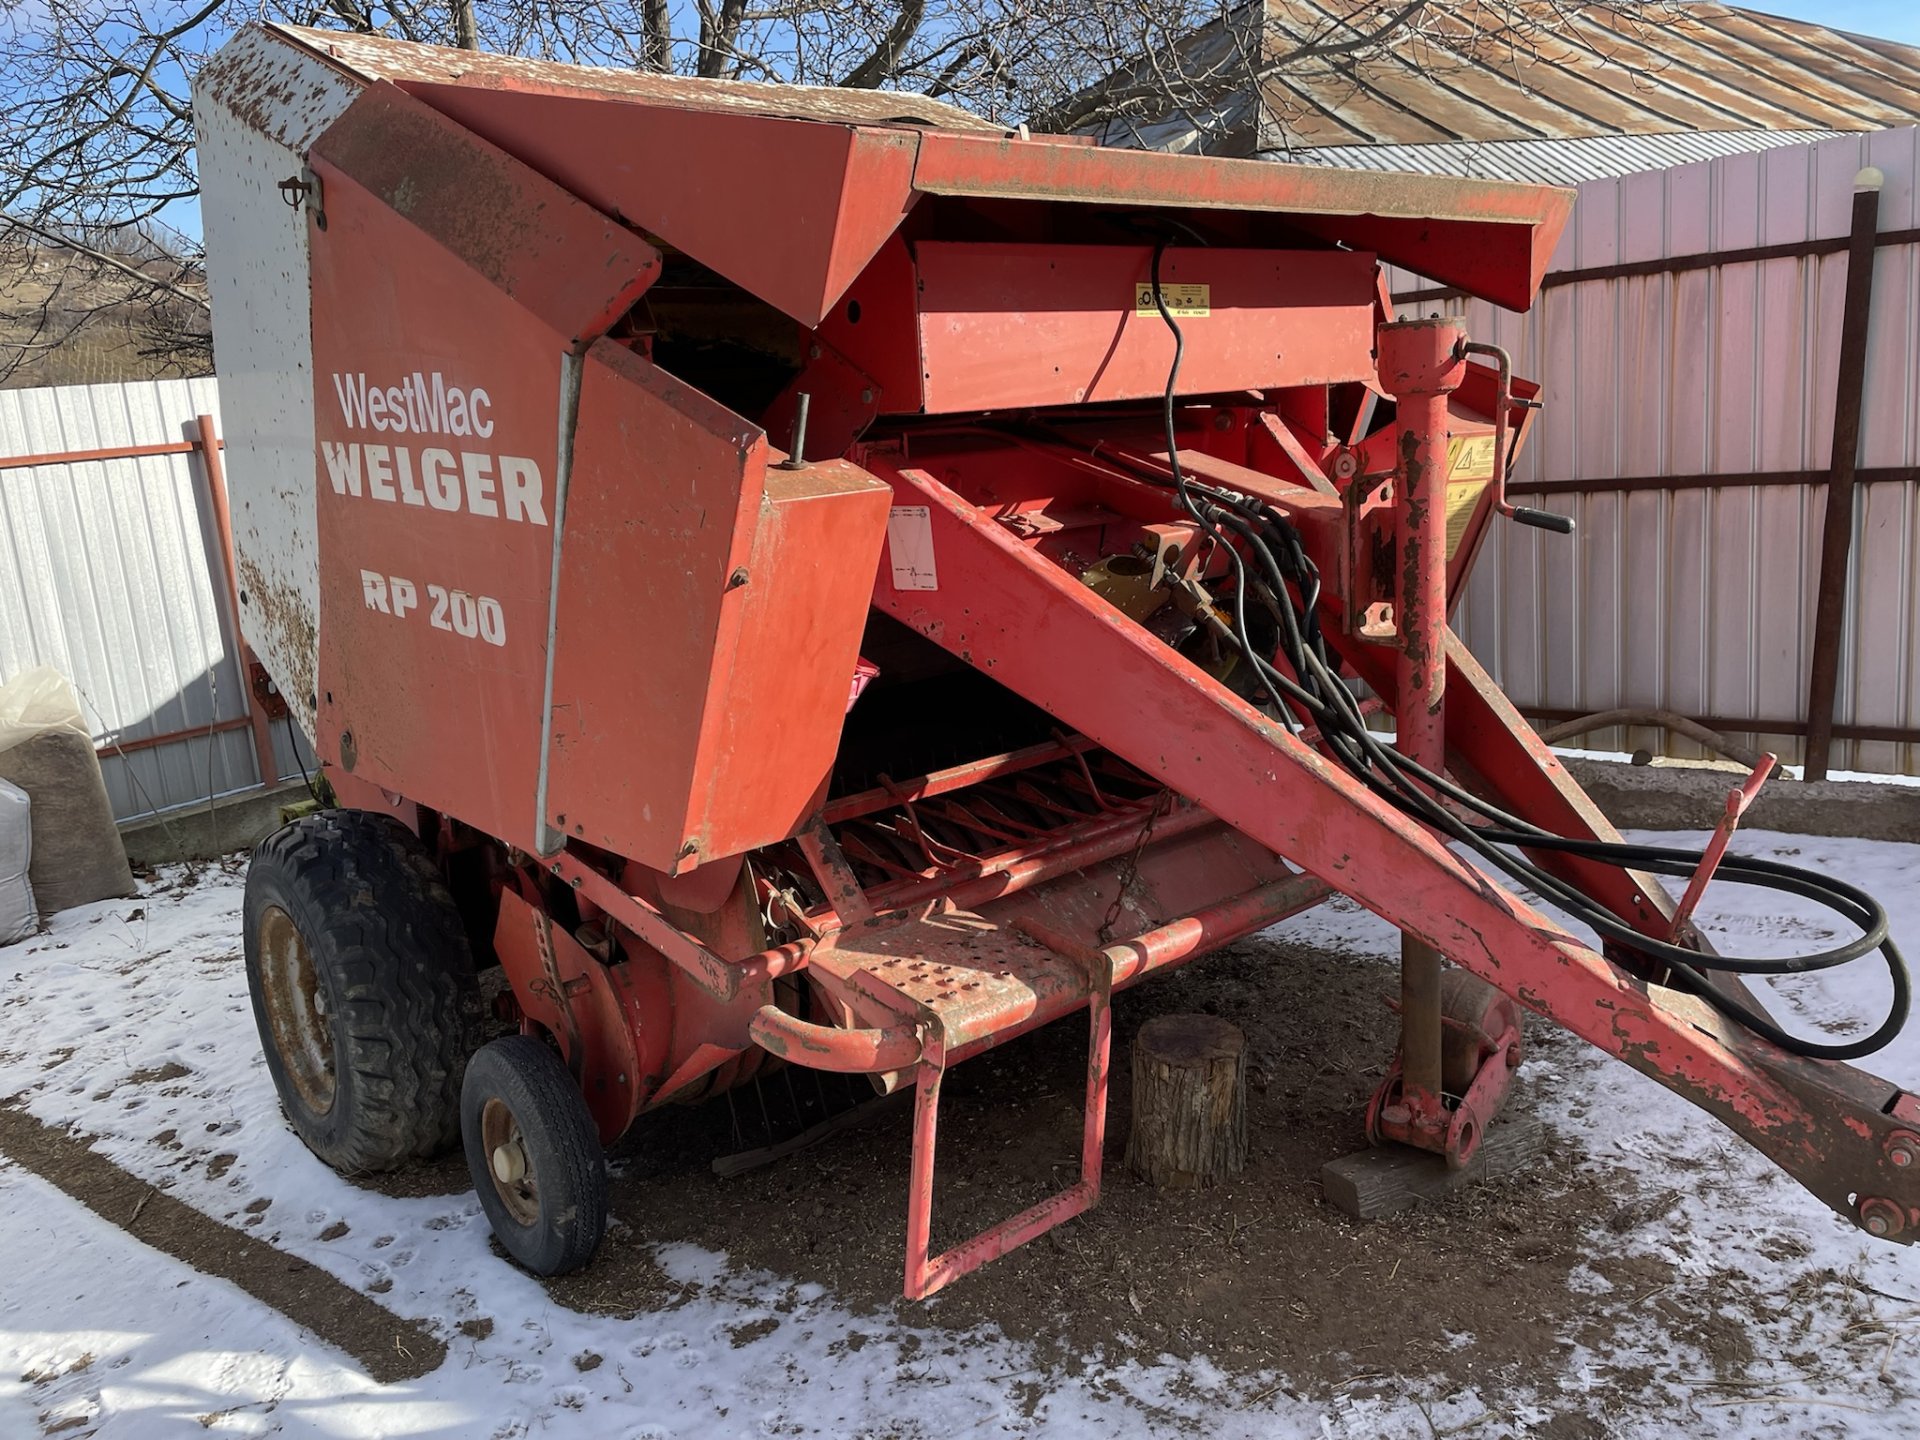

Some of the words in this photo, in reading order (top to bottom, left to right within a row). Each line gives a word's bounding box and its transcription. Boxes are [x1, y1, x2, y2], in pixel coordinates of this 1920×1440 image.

[333, 372, 494, 439] WestMac
[321, 441, 548, 526] WELGER
[360, 569, 417, 618] RP
[425, 583, 506, 647] 200
